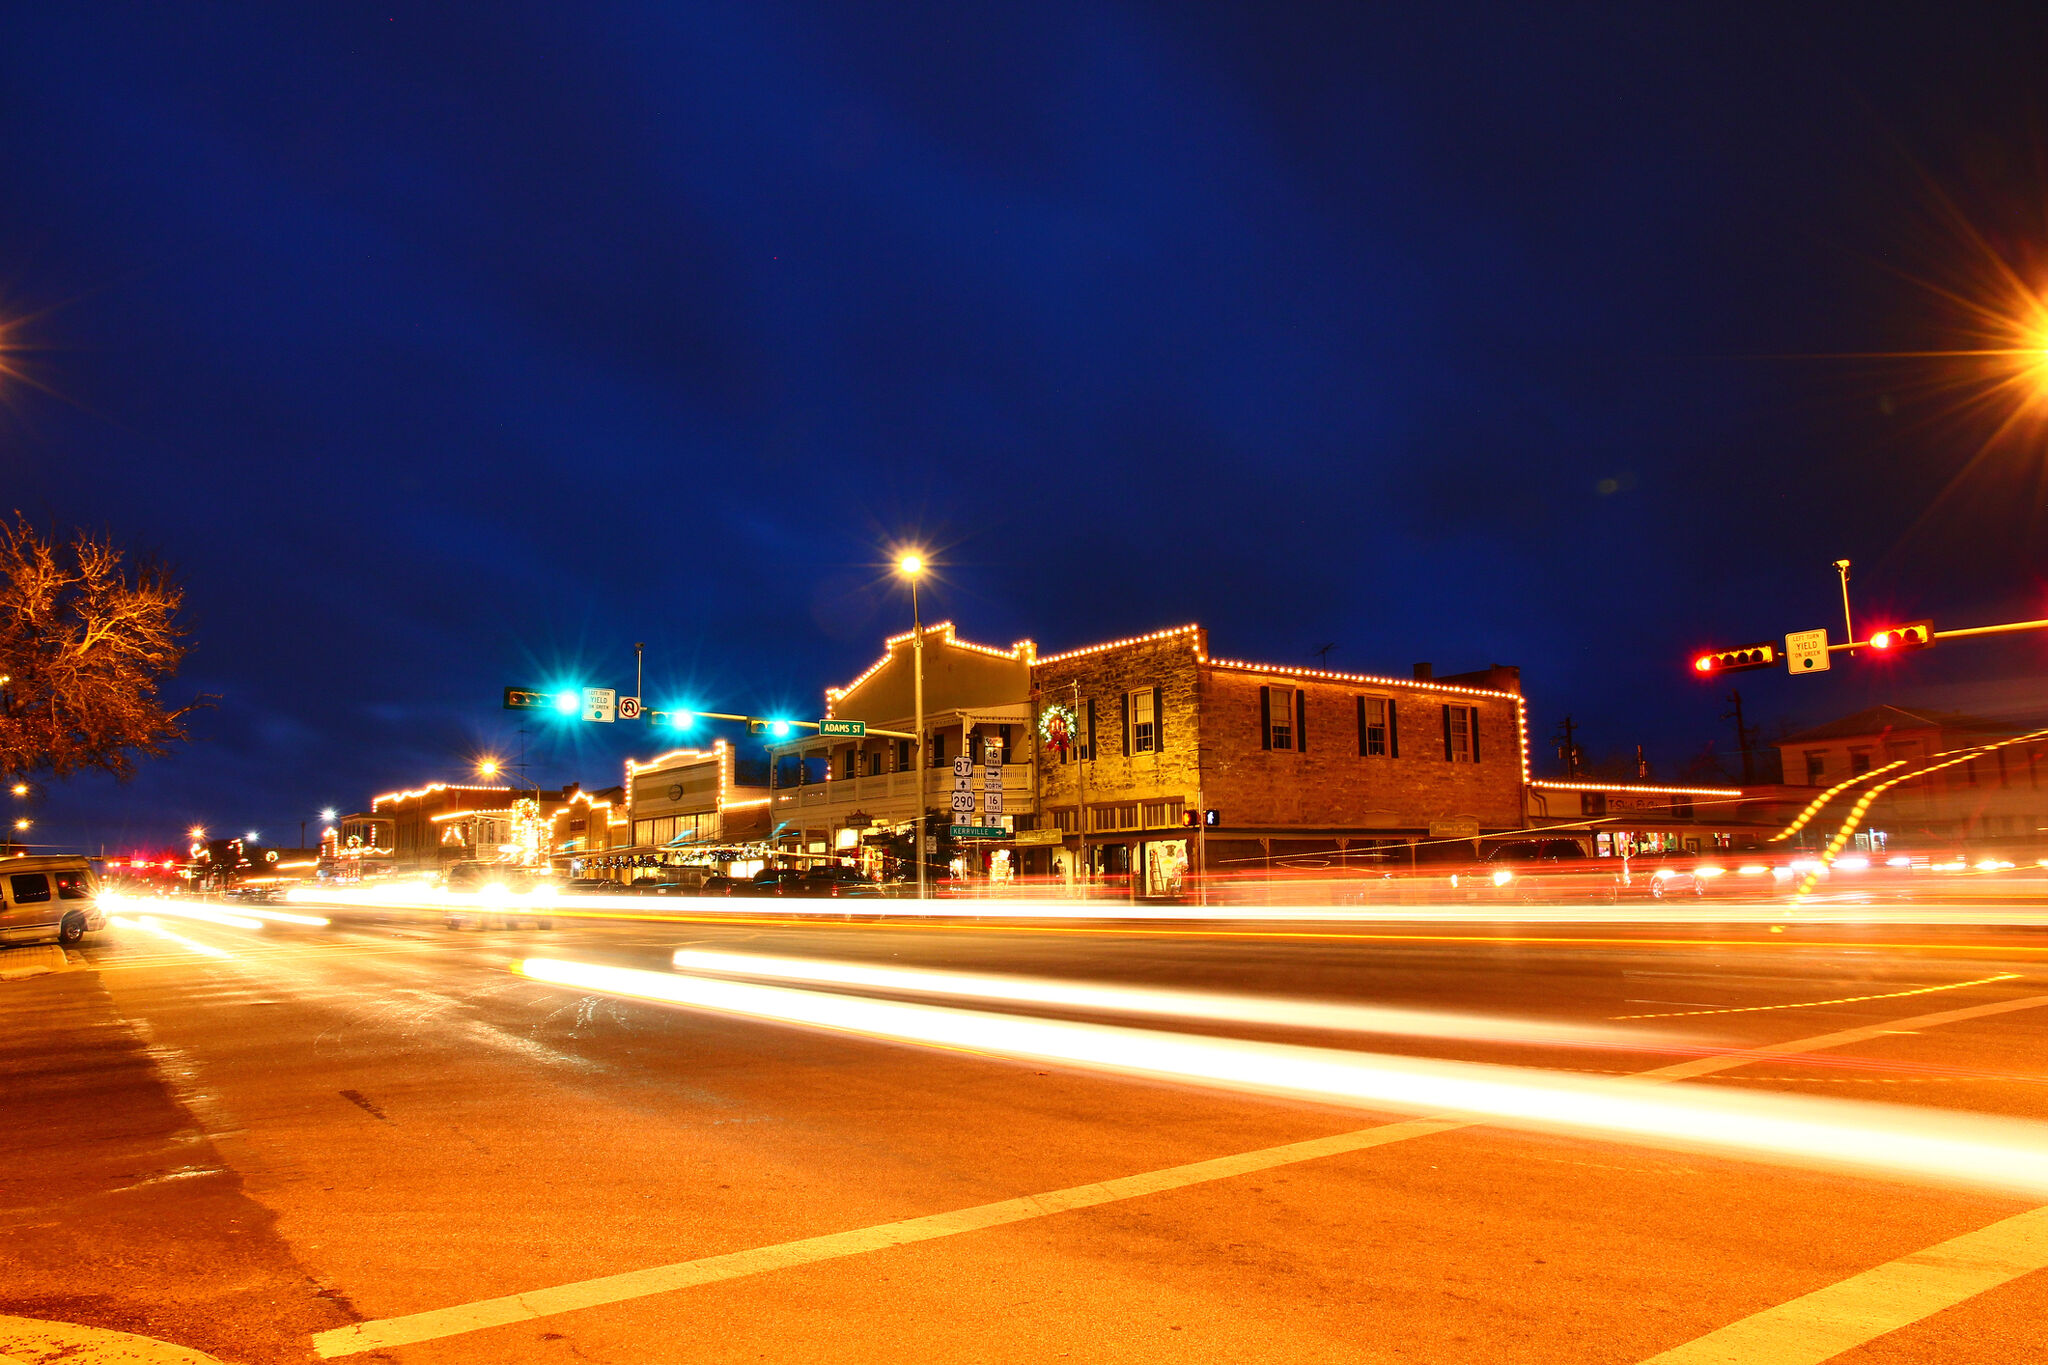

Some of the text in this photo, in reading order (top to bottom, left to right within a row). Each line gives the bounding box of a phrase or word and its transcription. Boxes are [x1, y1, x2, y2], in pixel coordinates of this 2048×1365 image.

[1797, 641, 1817, 650] YIELD
[824, 723, 861, 733] ADAMS ST
[989, 749, 998, 758] 16
[955, 761, 971, 772] 87
[953, 796, 973, 808] 290
[989, 796, 998, 804] 16
[953, 827, 988, 835] KERRVILLE
